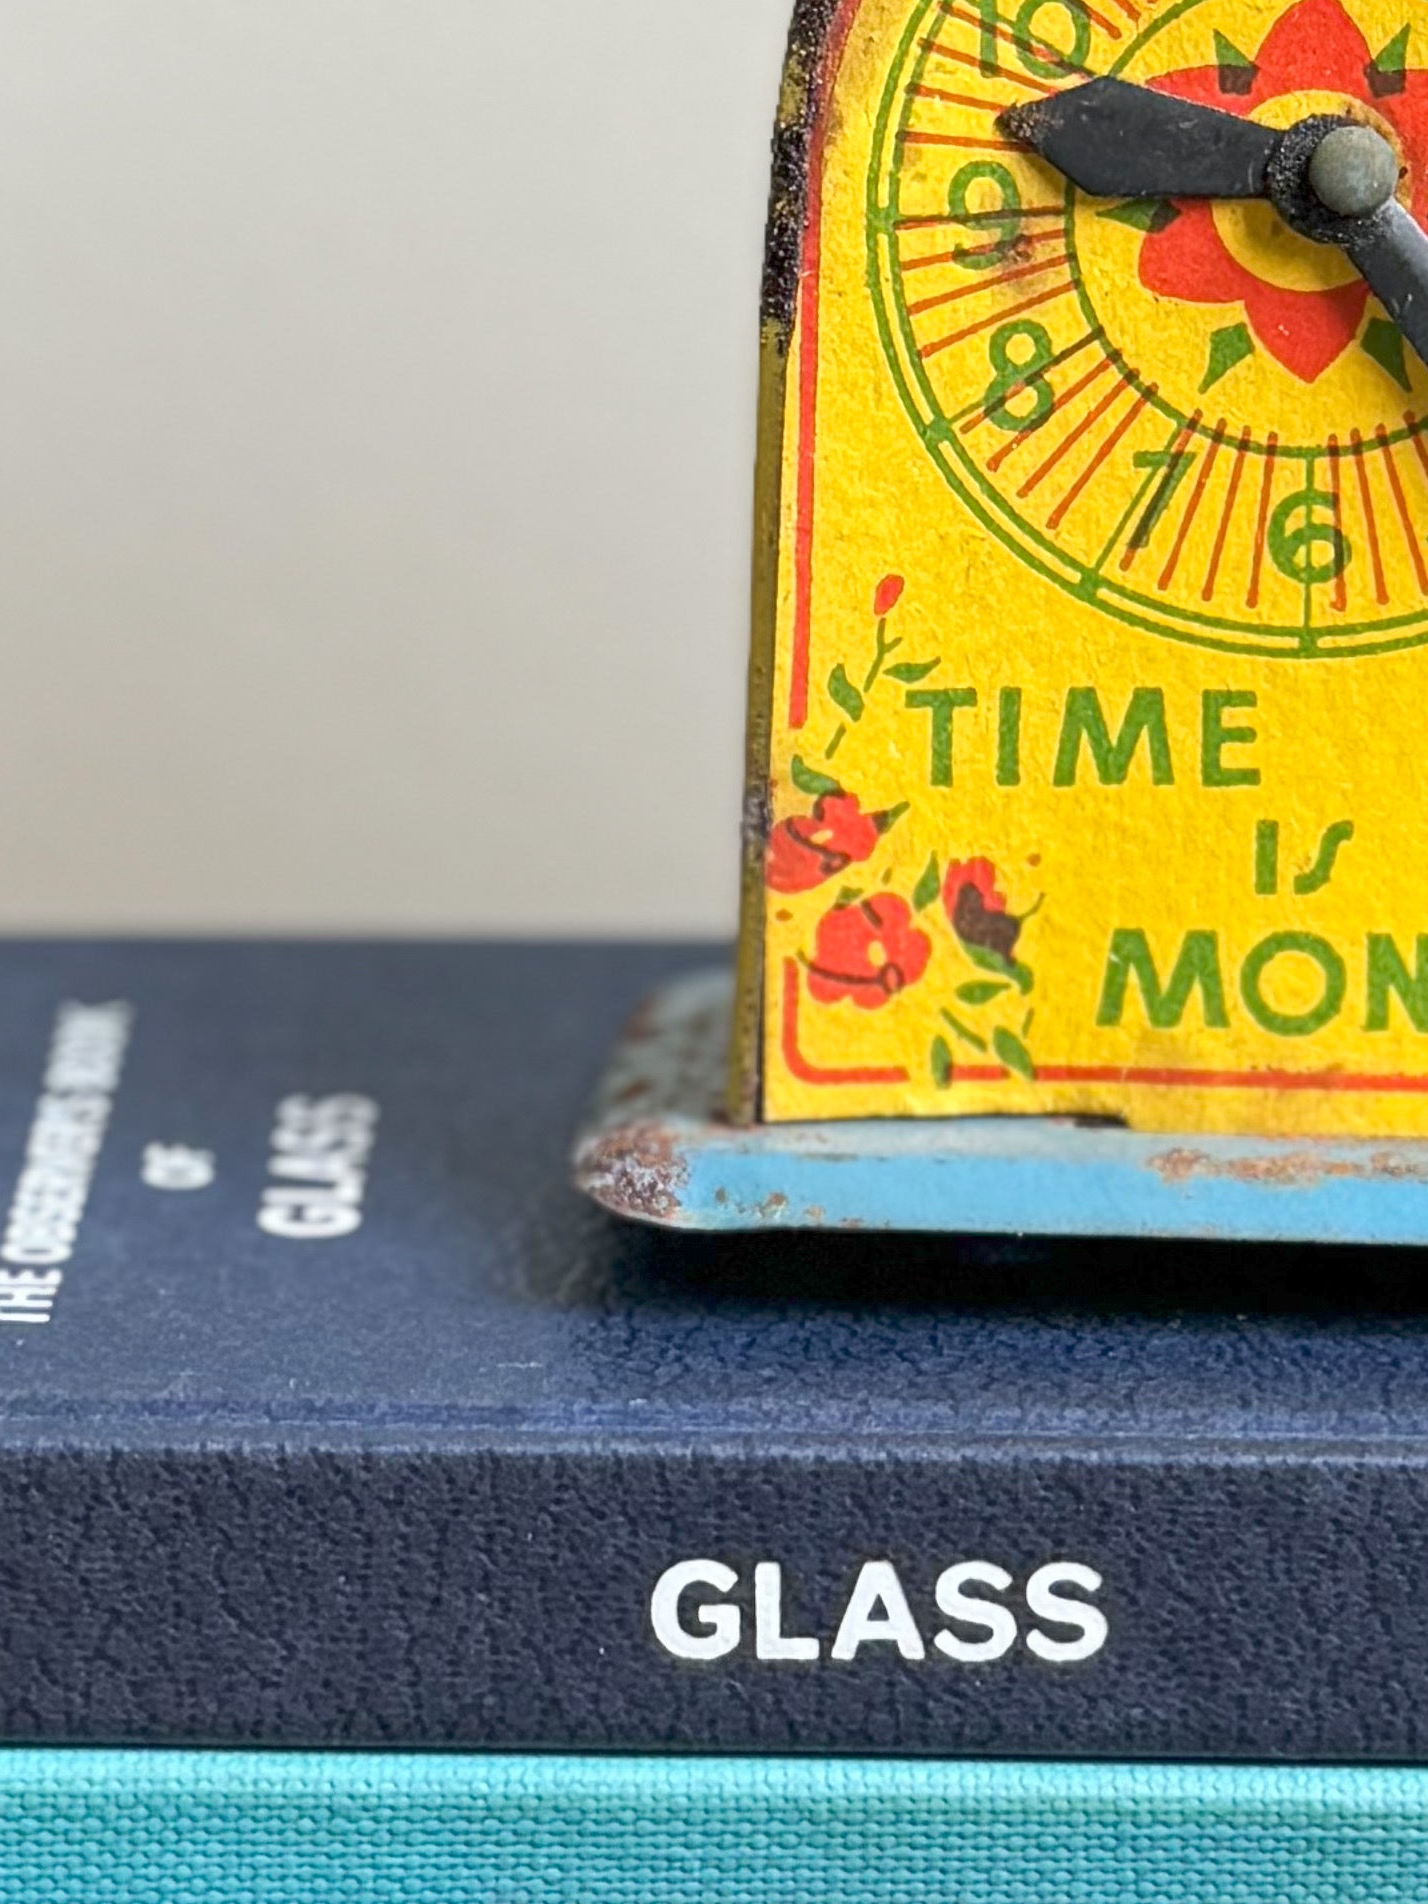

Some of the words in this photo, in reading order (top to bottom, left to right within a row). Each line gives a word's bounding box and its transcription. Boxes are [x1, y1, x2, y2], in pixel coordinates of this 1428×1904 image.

[948, 161, 1022, 269] 9
[984, 319, 1053, 431] 8
[1133, 451, 1196, 547] 7
[1268, 490, 1352, 583] 6
[905, 686, 1261, 787] TIME
[1255, 819, 1354, 897] IS
[255, 1095, 378, 1239] GLASS
[650, 1558, 1109, 1663] GLASS
